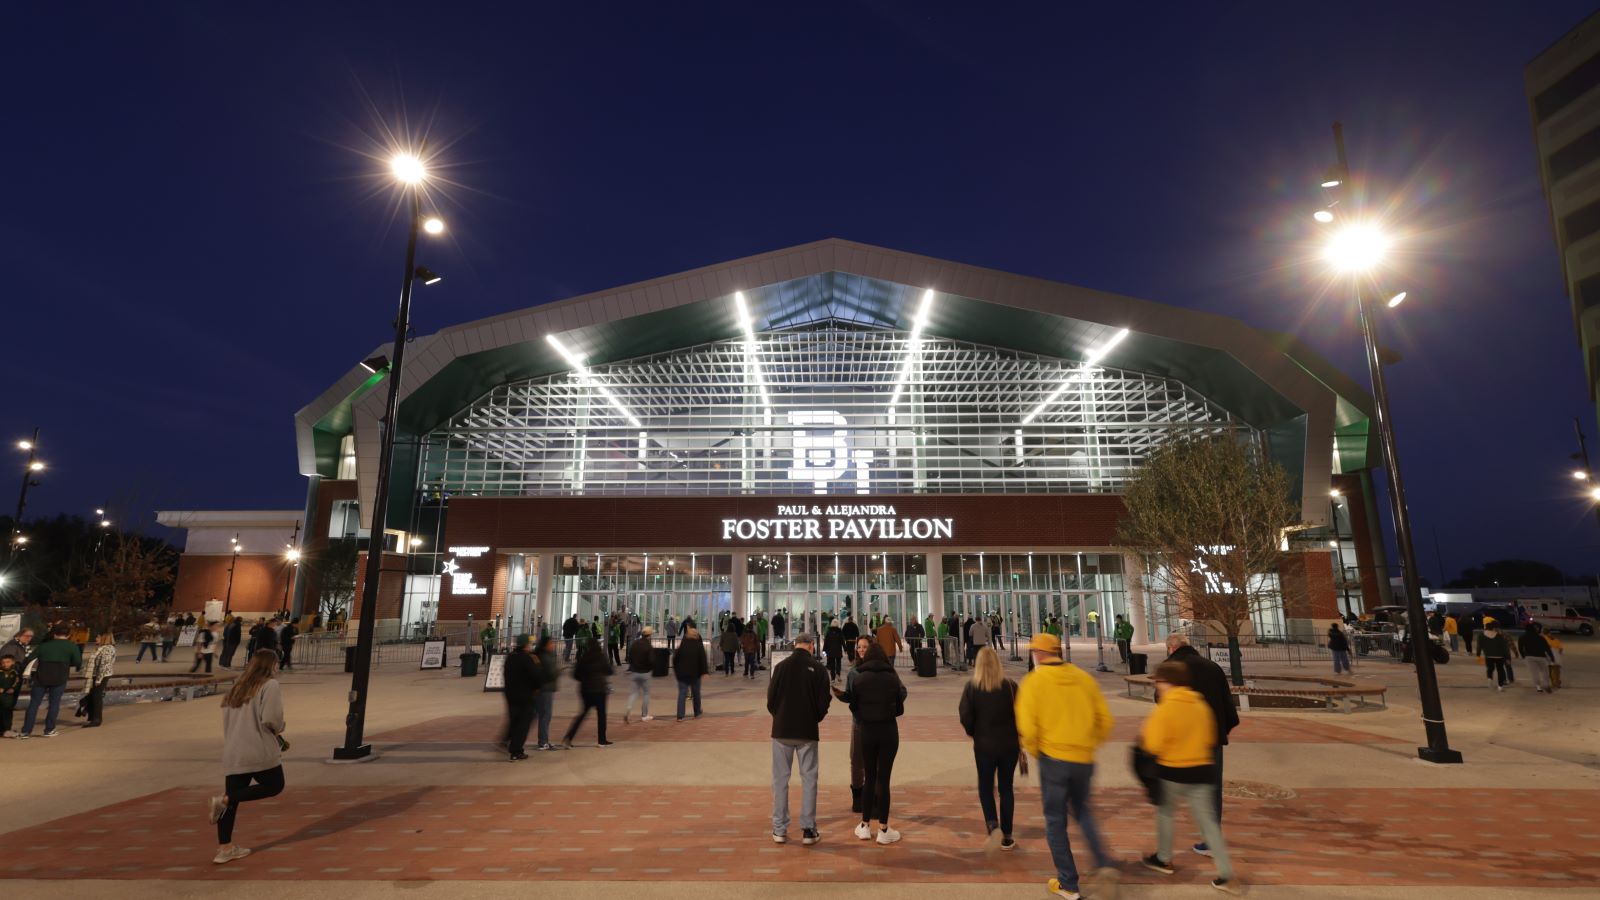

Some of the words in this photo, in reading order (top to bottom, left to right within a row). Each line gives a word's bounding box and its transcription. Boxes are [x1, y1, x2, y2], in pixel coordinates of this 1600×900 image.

[778, 505, 809, 515] PAUL
[811, 505, 822, 515] &
[825, 505, 896, 516] ALEJANDRA
[722, 518, 822, 539] FOSTER
[828, 518, 953, 539] PAVILION
